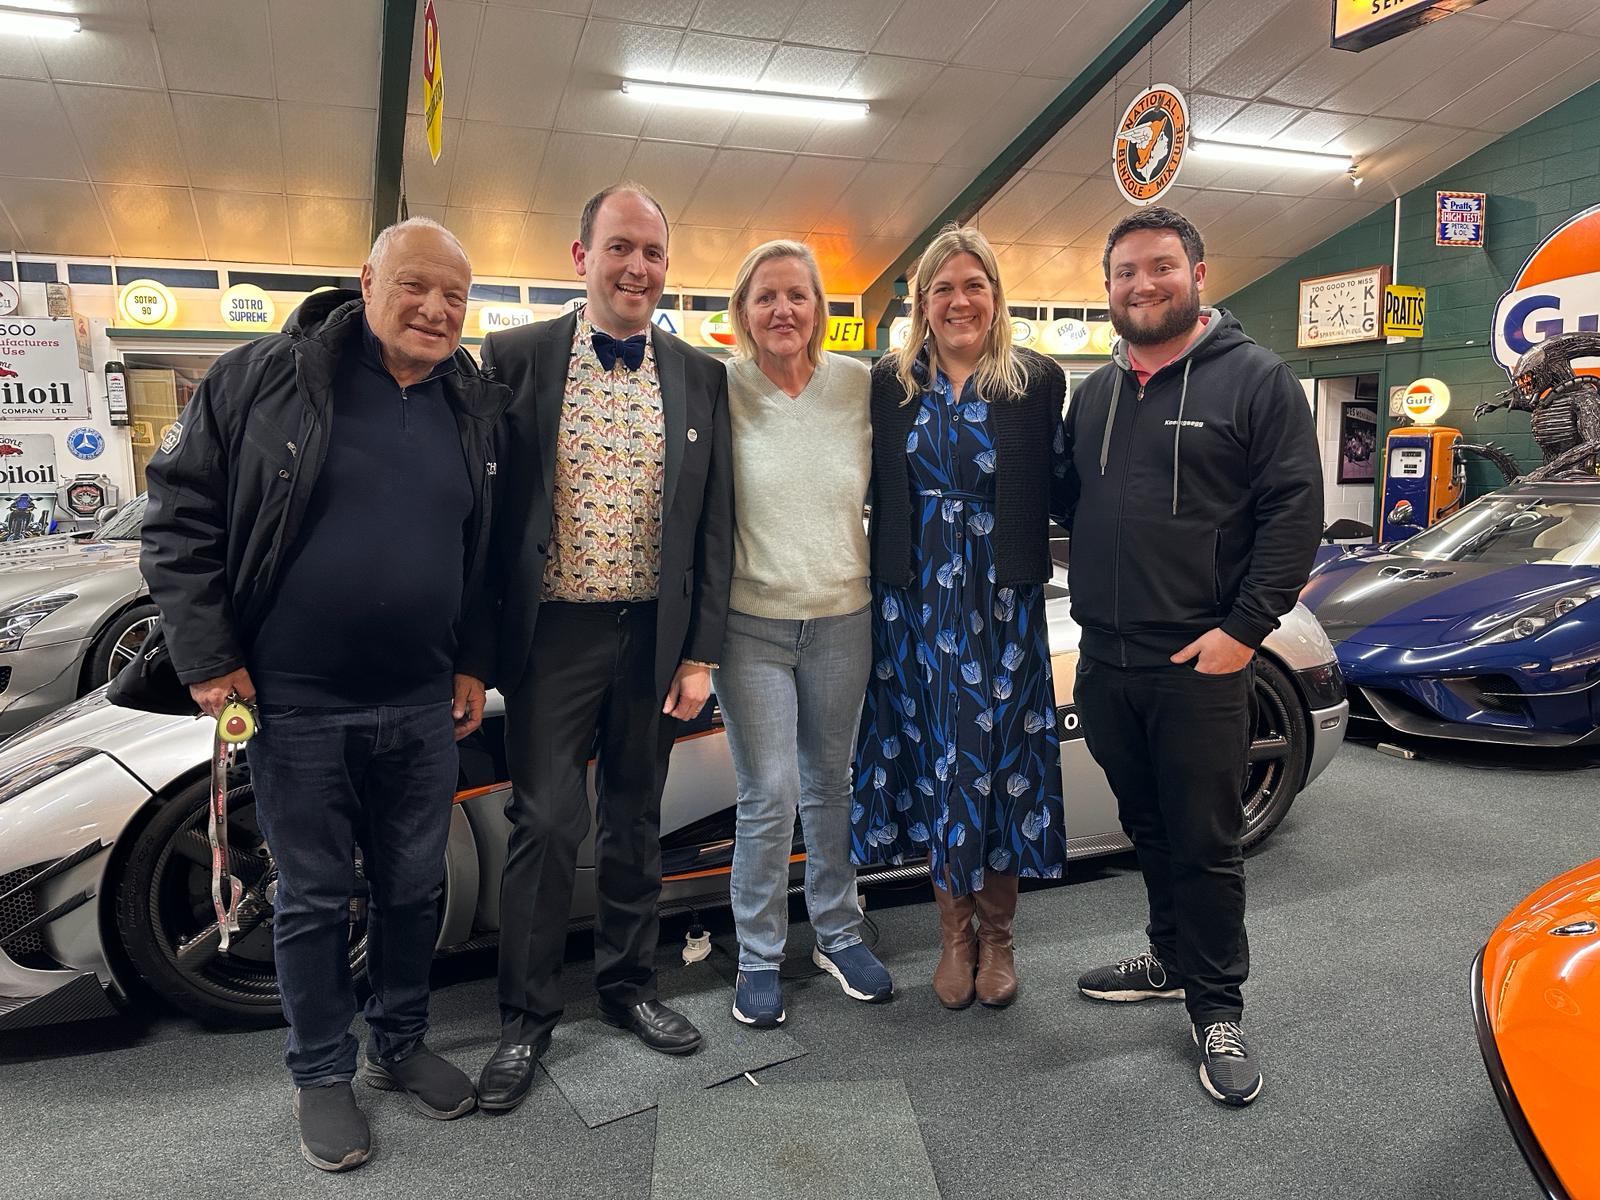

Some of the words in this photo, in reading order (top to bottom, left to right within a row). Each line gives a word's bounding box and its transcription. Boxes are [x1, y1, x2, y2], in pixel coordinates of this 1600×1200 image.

[1371, 0, 1404, 14] SE
[1125, 94, 1176, 129] NATIONAL
[1155, 123, 1184, 191] MIXTURE
[1118, 148, 1144, 197] BENZOLE
[1450, 200, 1472, 211] Pratts
[1444, 212, 1461, 222] HIGH
[1463, 213, 1479, 223] TEST
[1312, 285, 1325, 293] TOO
[1326, 282, 1346, 291] GOOD
[1347, 280, 1356, 288] TO
[1357, 277, 1374, 285] MISS
[134, 295, 158, 305] SOTRO
[232, 298, 263, 310] SOTRO
[141, 306, 152, 315] 90
[1362, 284, 1375, 333] KLG
[229, 311, 268, 323] SUPREME
[488, 312, 529, 326] Mobil
[829, 322, 863, 342] JET
[2, 347, 26, 356] Use
[1405, 395, 1435, 405] Gulf
